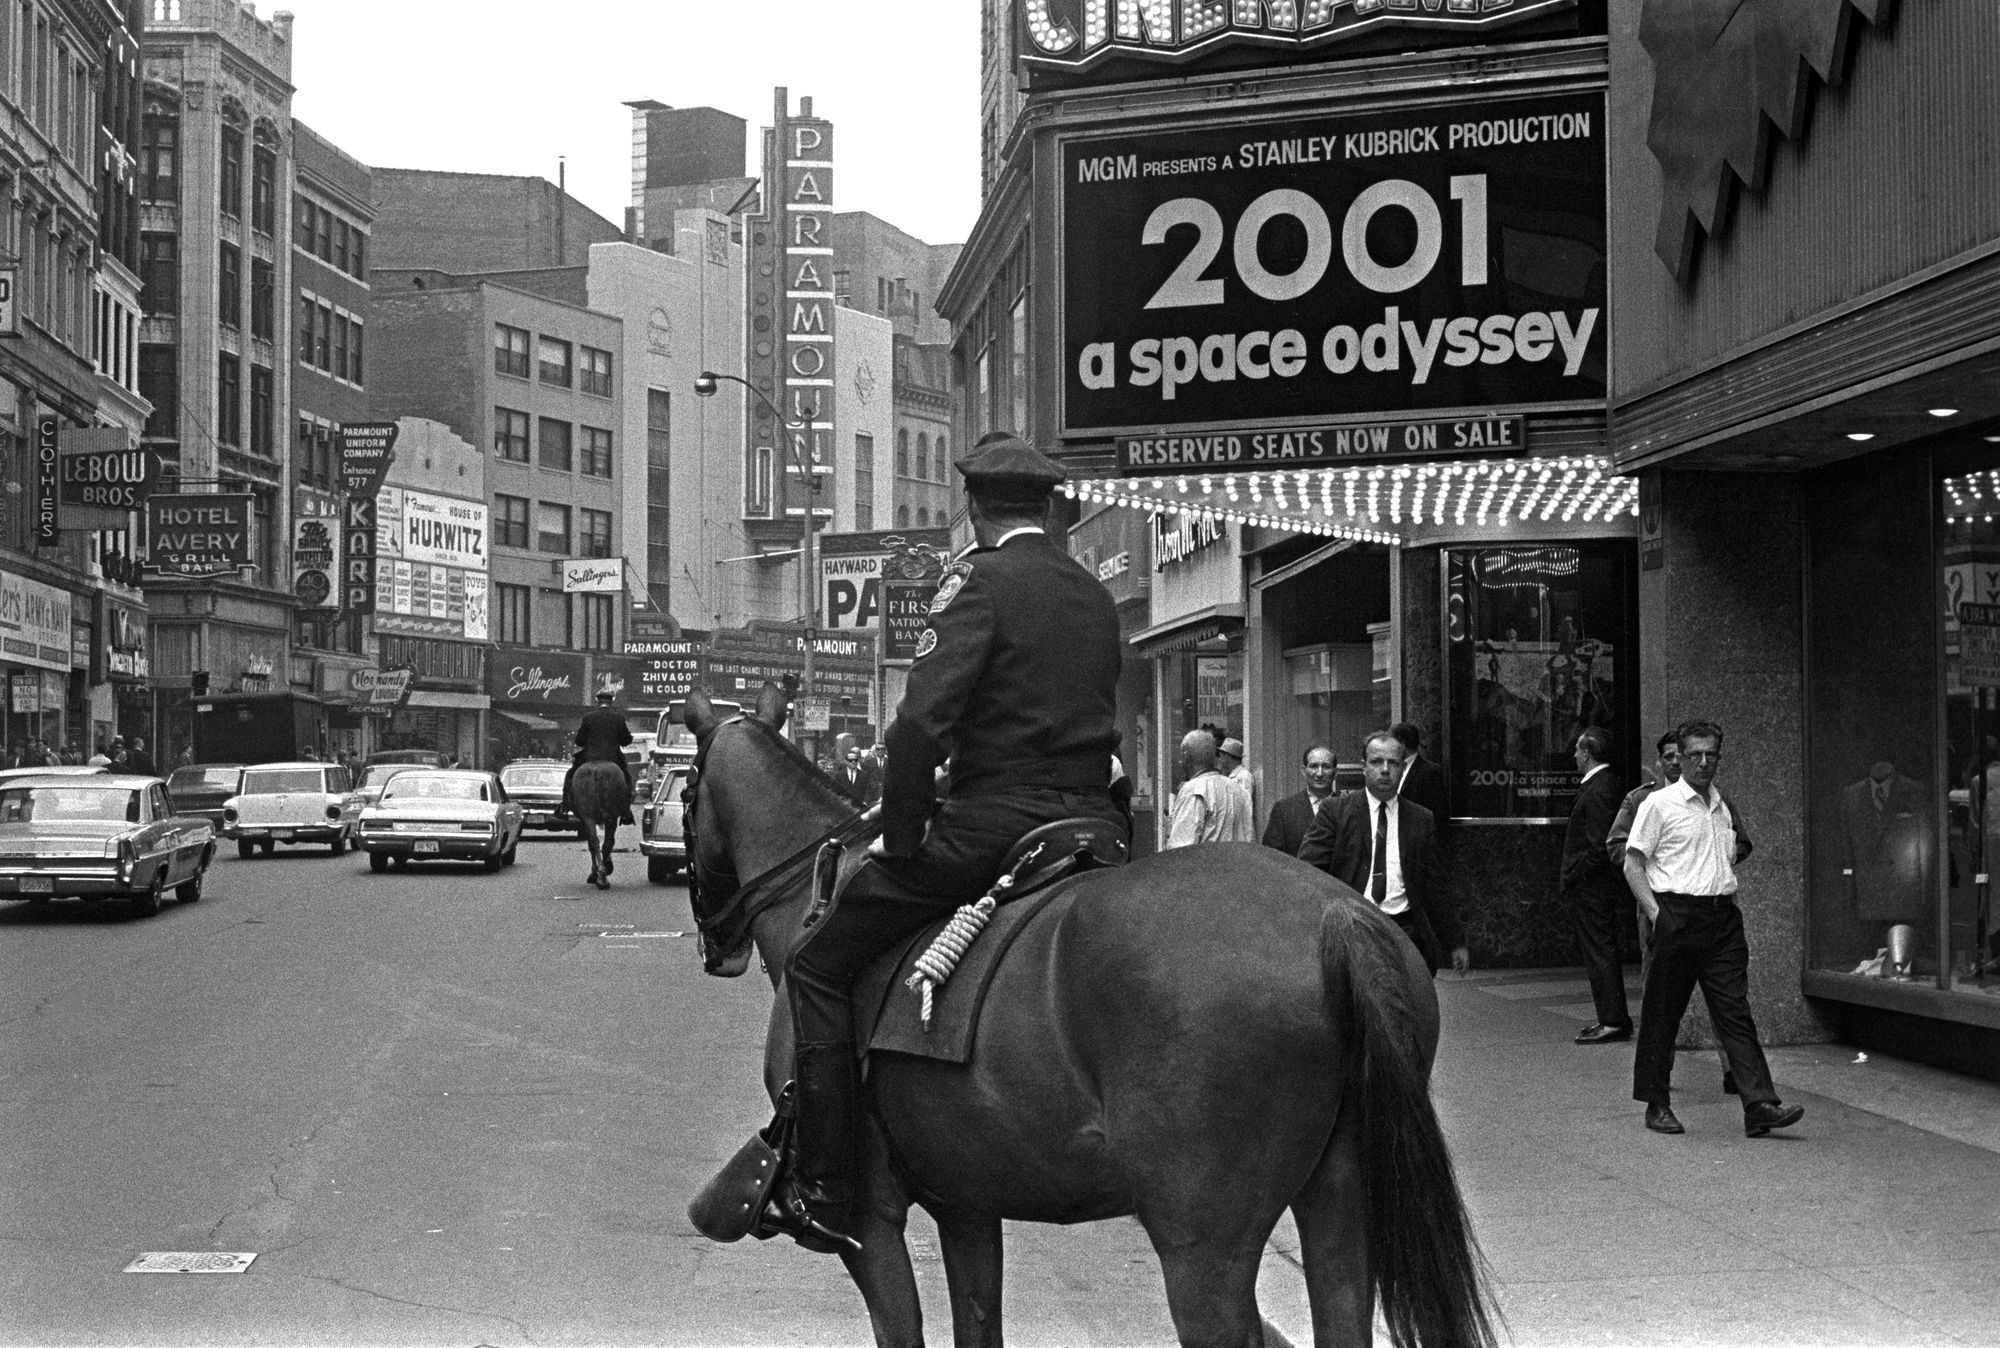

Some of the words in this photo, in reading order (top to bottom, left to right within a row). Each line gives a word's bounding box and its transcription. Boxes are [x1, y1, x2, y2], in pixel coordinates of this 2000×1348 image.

[1024, 0, 1515, 55] CINE
[1079, 155, 1137, 183] MGM
[1143, 158, 1217, 178] PRESENTS
[1222, 155, 1234, 171] A
[1240, 136, 1336, 168] STANLEY
[1345, 127, 1440, 158] KUBRICK
[1449, 112, 1591, 150] PRODUCTION
[1141, 173, 1488, 310] 2001
[791, 127, 827, 466] PARAMOUN
[1079, 340, 1116, 390] a
[1129, 329, 1307, 401] space
[1322, 306, 1599, 385] odyssey
[343, 427, 393, 437] PARAMOUNT
[346, 438, 386, 448] UNIFORM
[1128, 438, 1242, 466] RESERVED
[1253, 432, 1323, 460] SEATS
[1336, 429, 1388, 455] NOW
[1404, 426, 1437, 452] ON
[1454, 419, 1513, 448] SALE
[343, 449, 384, 458] COMPANY
[64, 451, 146, 484] LEBOW
[342, 463, 377, 476] Entrance
[41, 420, 55, 538] CLOTHIERS
[348, 476, 367, 489] 577
[82, 486, 143, 508] BROS.
[159, 508, 239, 526] HOTEL
[449, 506, 471, 520] HOUSE
[473, 510, 482, 521] OF
[157, 532, 241, 551] AVERY
[409, 516, 483, 556] HURWITZ
[169, 553, 232, 563] GRILL
[348, 501, 371, 609] KARP
[181, 563, 214, 573] BAR
[825, 558, 877, 576] HAYWARD
[300, 573, 326, 589] 40
[566, 567, 618, 588] Sallingers
[904, 590, 923, 598] The
[828, 578, 880, 629] PA
[888, 617, 928, 628] NATION
[895, 631, 923, 640] BAN
[624, 642, 693, 654] PARAMOUNT
[797, 637, 858, 655] PAMOUNT
[648, 660, 698, 670] "DOCTOR
[725, 664, 739, 674] LAST
[355, 670, 406, 688] Normandy
[507, 666, 572, 699] Sallingers
[642, 672, 699, 682] ZHIVAGO"
[1199, 675, 1227, 696] IMPOR
[374, 688, 399, 700] LOUNGE
[643, 684, 653, 694] IN
[657, 684, 691, 694] COLOR
[1530, 774, 1567, 788] space
